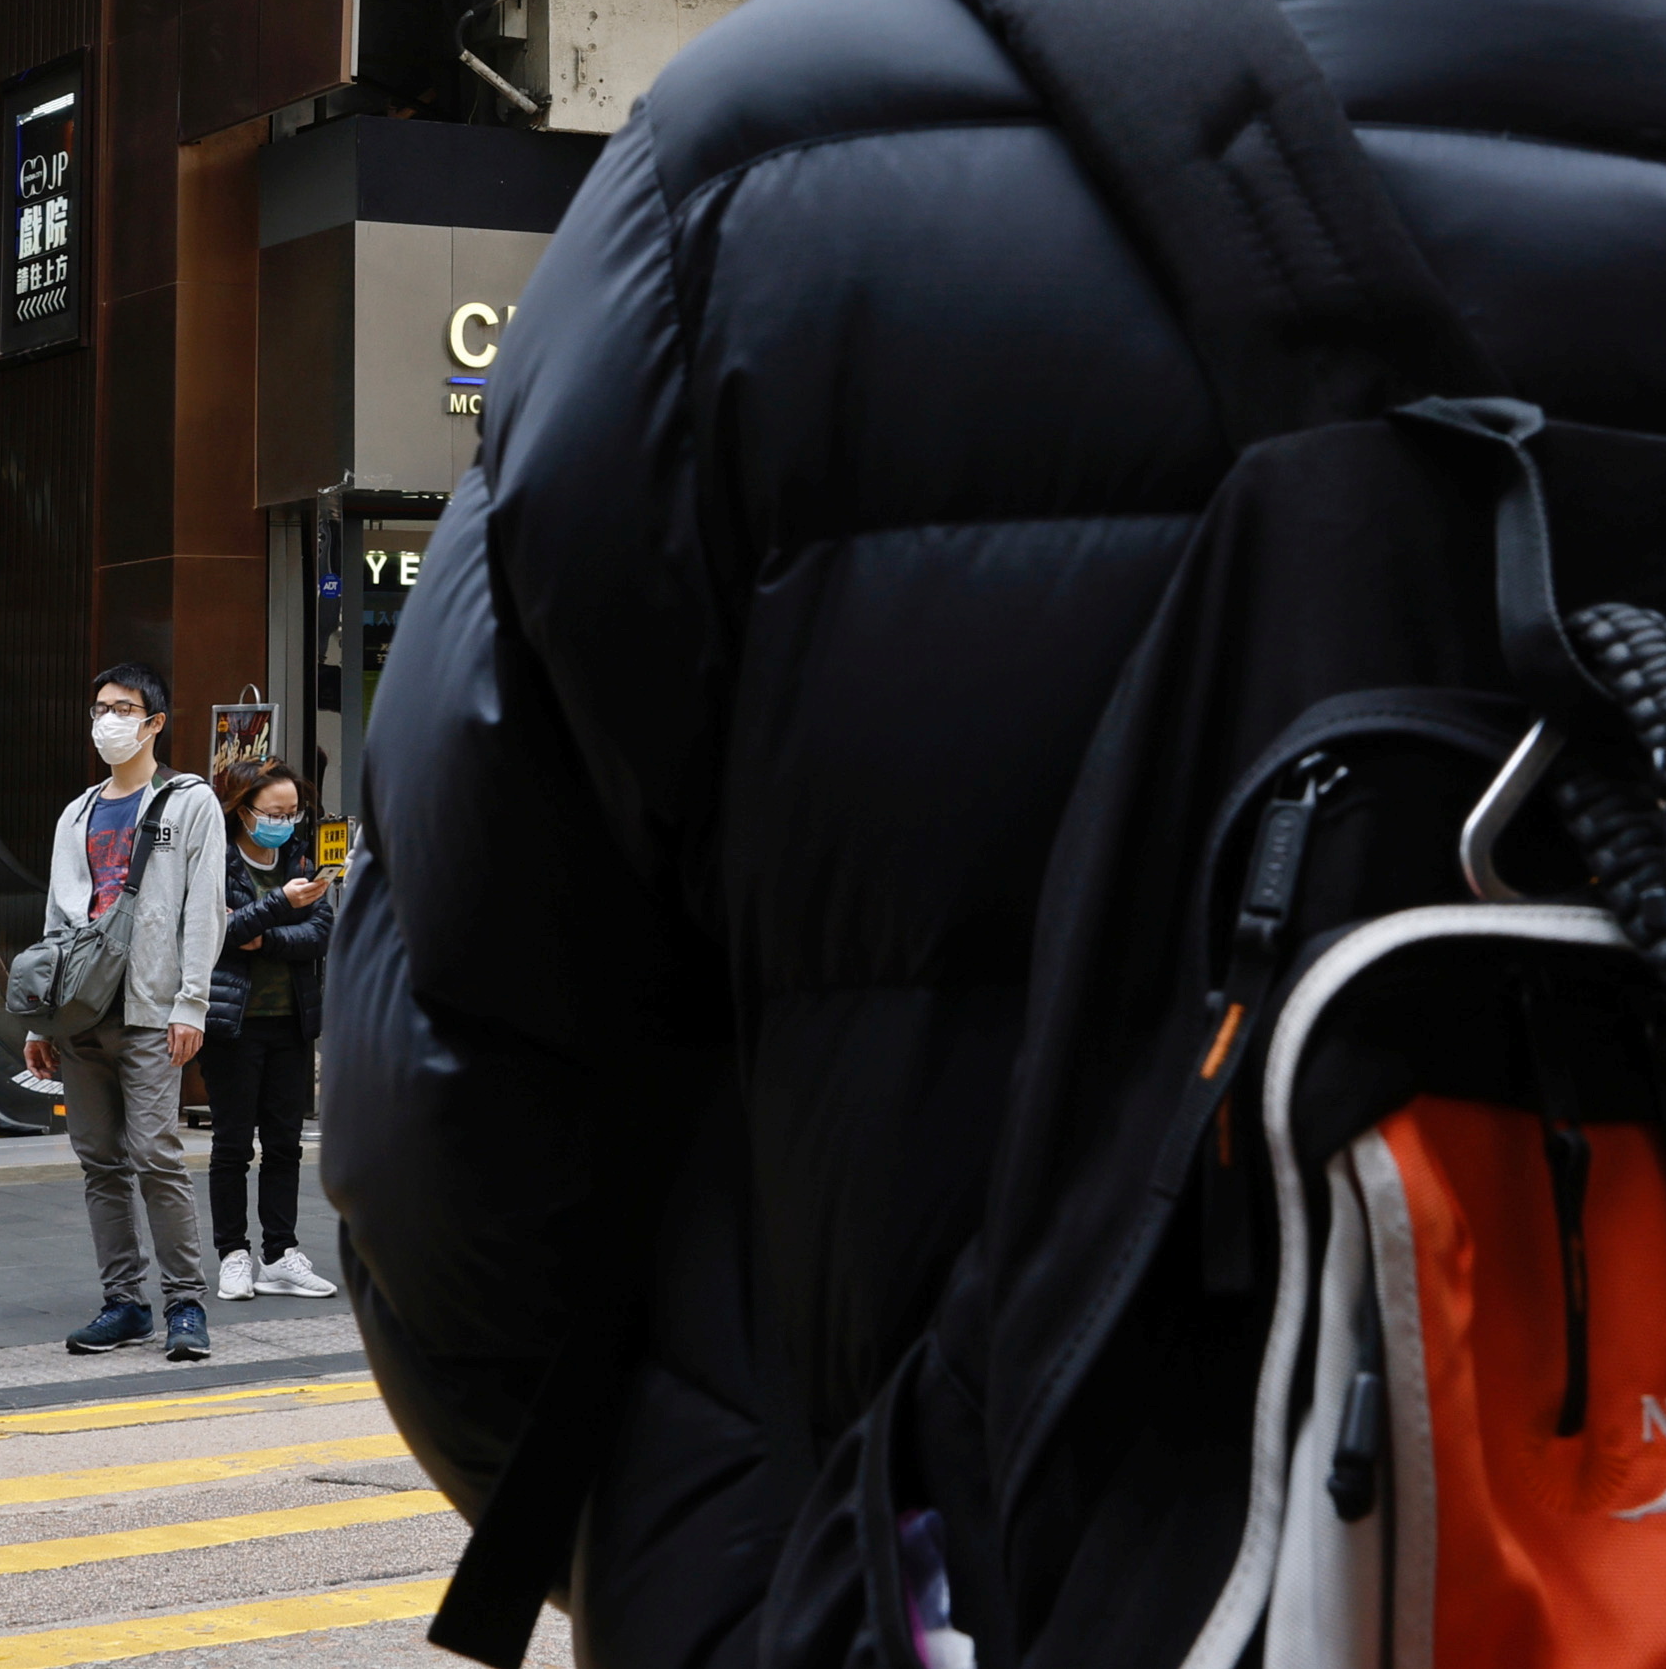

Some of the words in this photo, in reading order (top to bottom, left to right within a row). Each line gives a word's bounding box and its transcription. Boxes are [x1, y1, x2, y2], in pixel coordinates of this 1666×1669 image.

[47, 150, 69, 191] JP
[18, 195, 69, 261] 戲院
[323, 580, 338, 591] ADT
